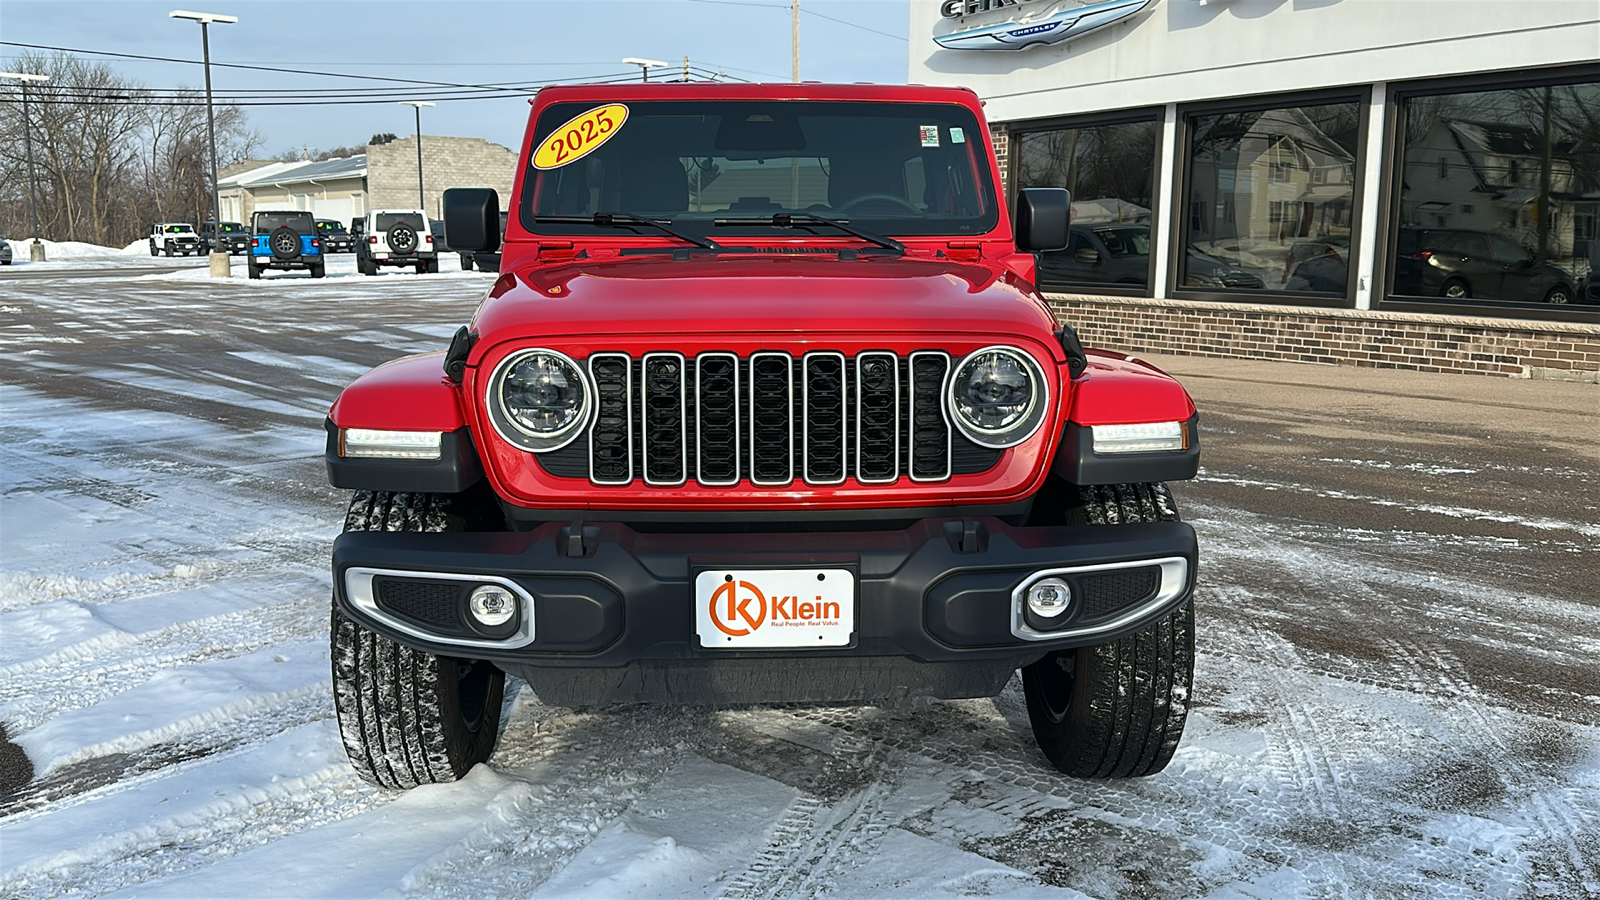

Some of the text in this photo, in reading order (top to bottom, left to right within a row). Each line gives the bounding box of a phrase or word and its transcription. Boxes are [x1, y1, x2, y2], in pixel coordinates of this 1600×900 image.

[1012, 24, 1055, 36] CHRYSLER
[550, 109, 613, 163] 2025
[771, 595, 840, 620] Klein
